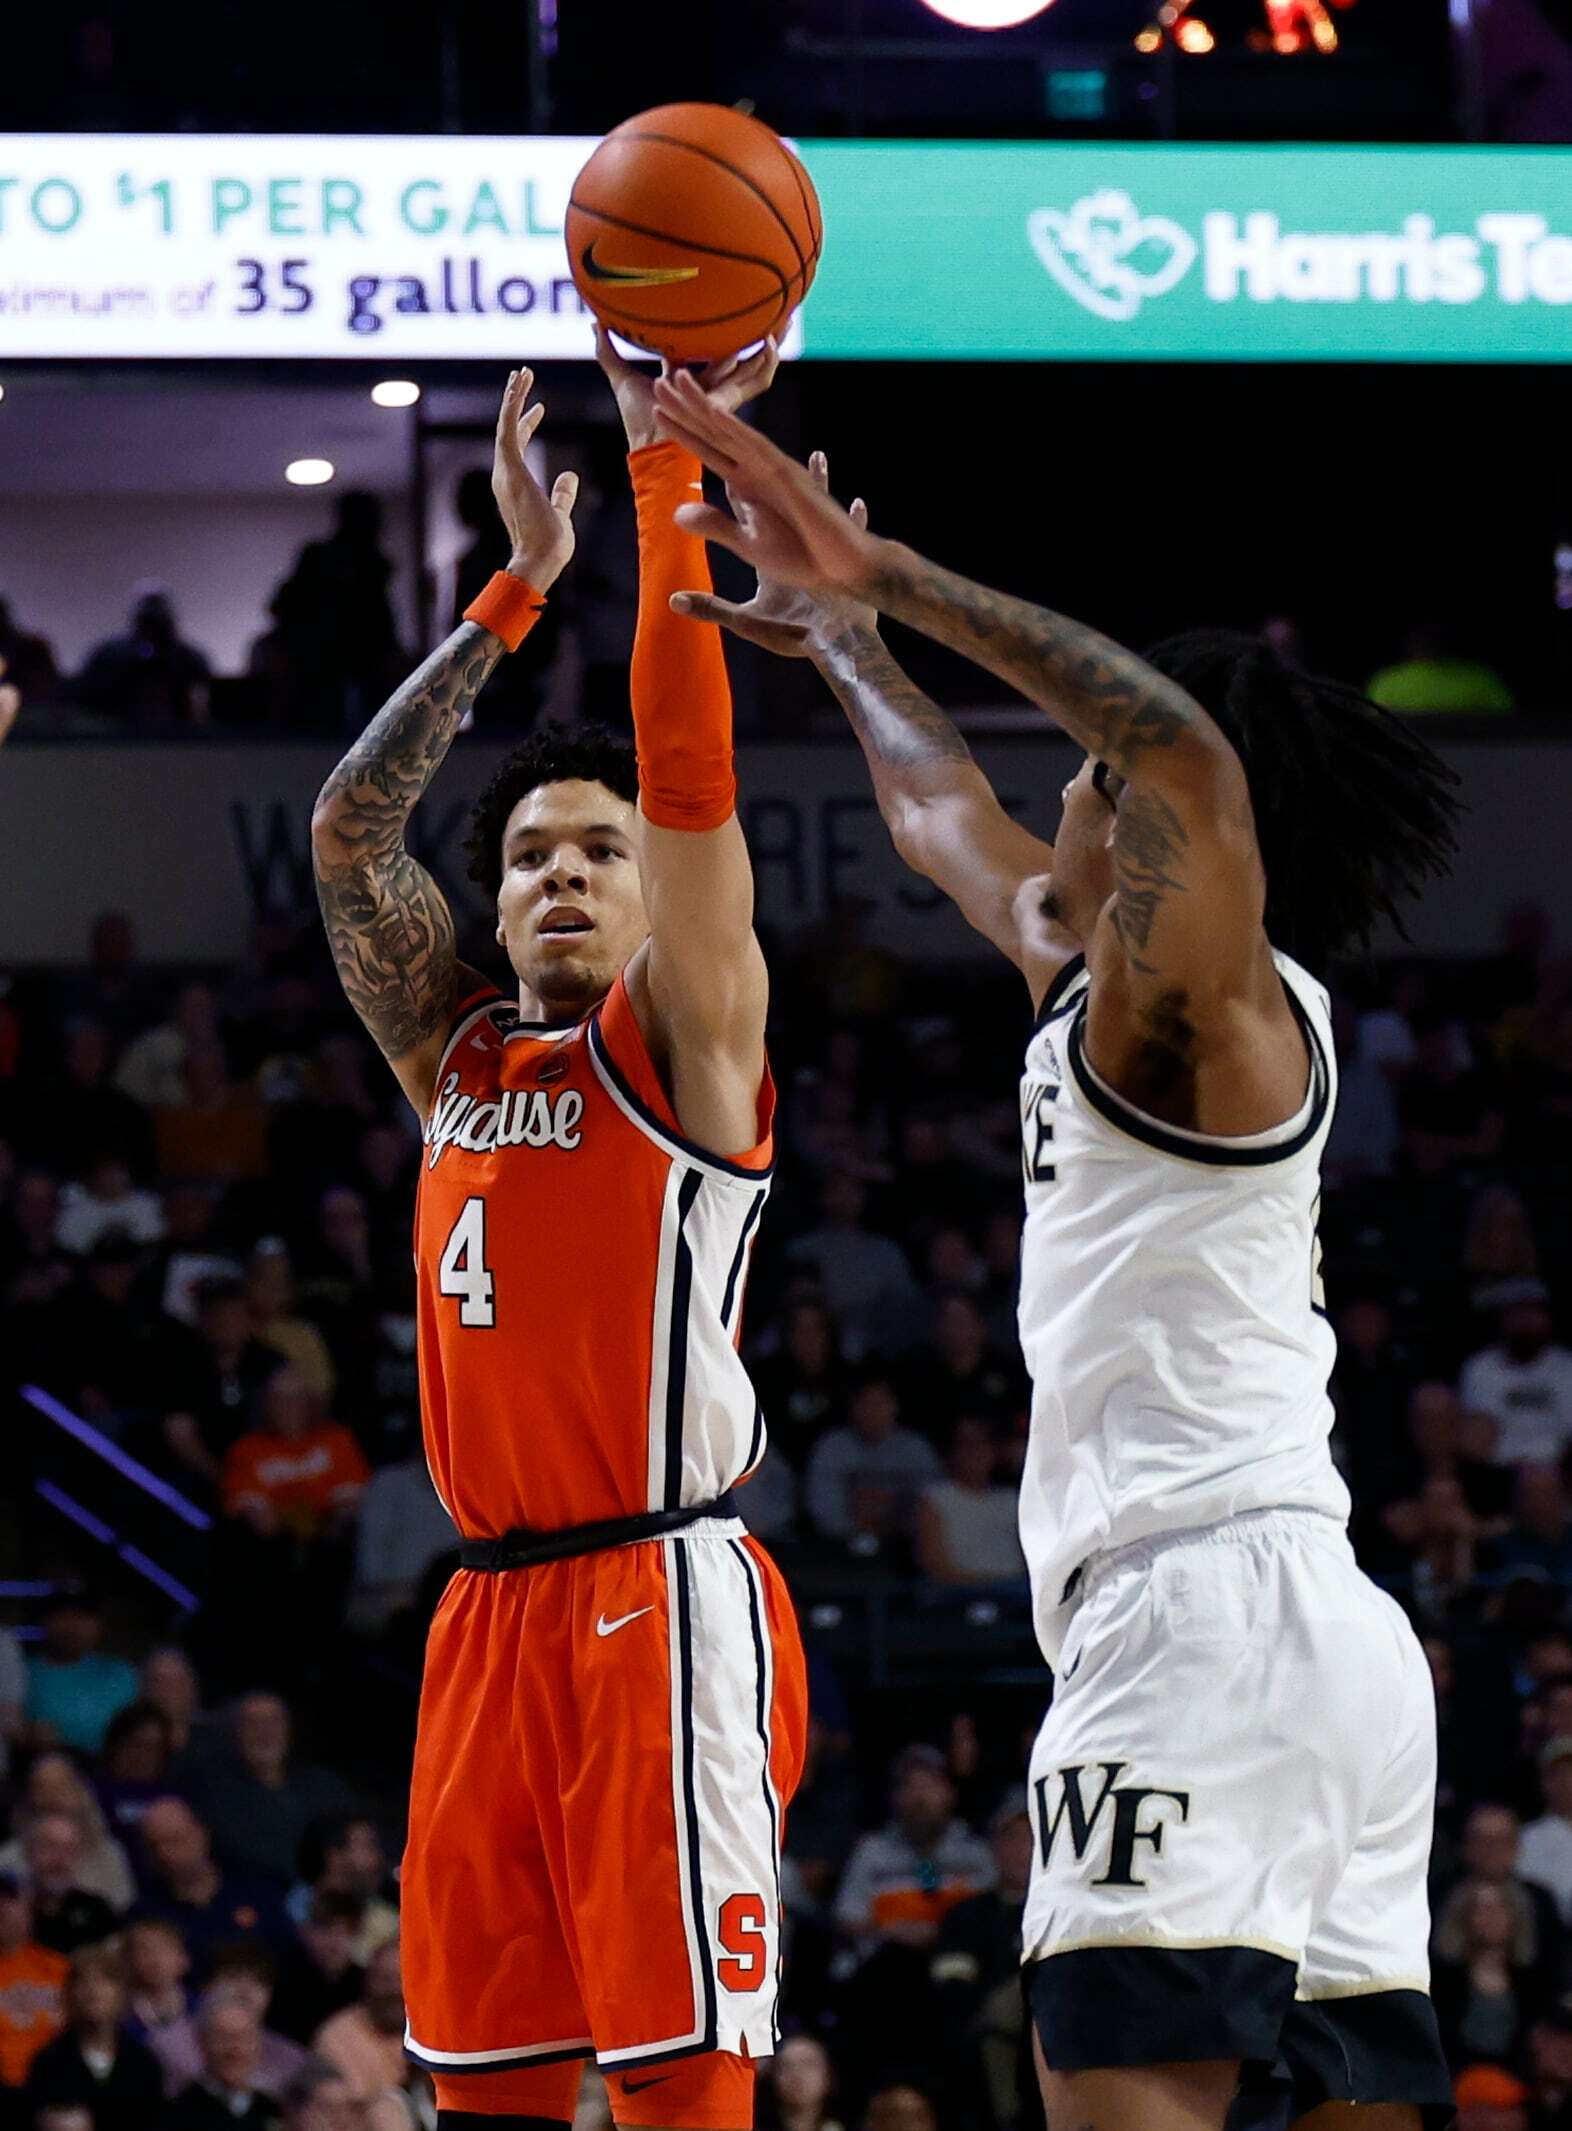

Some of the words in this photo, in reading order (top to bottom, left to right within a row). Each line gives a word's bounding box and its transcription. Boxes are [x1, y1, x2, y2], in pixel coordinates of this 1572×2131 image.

[212, 177, 364, 236] PER
[236, 258, 313, 313] 35
[1204, 211, 1485, 303] Harris
[439, 1196, 496, 1328] 4
[1034, 1762, 1189, 1887] WF
[717, 1893, 767, 1992] S
